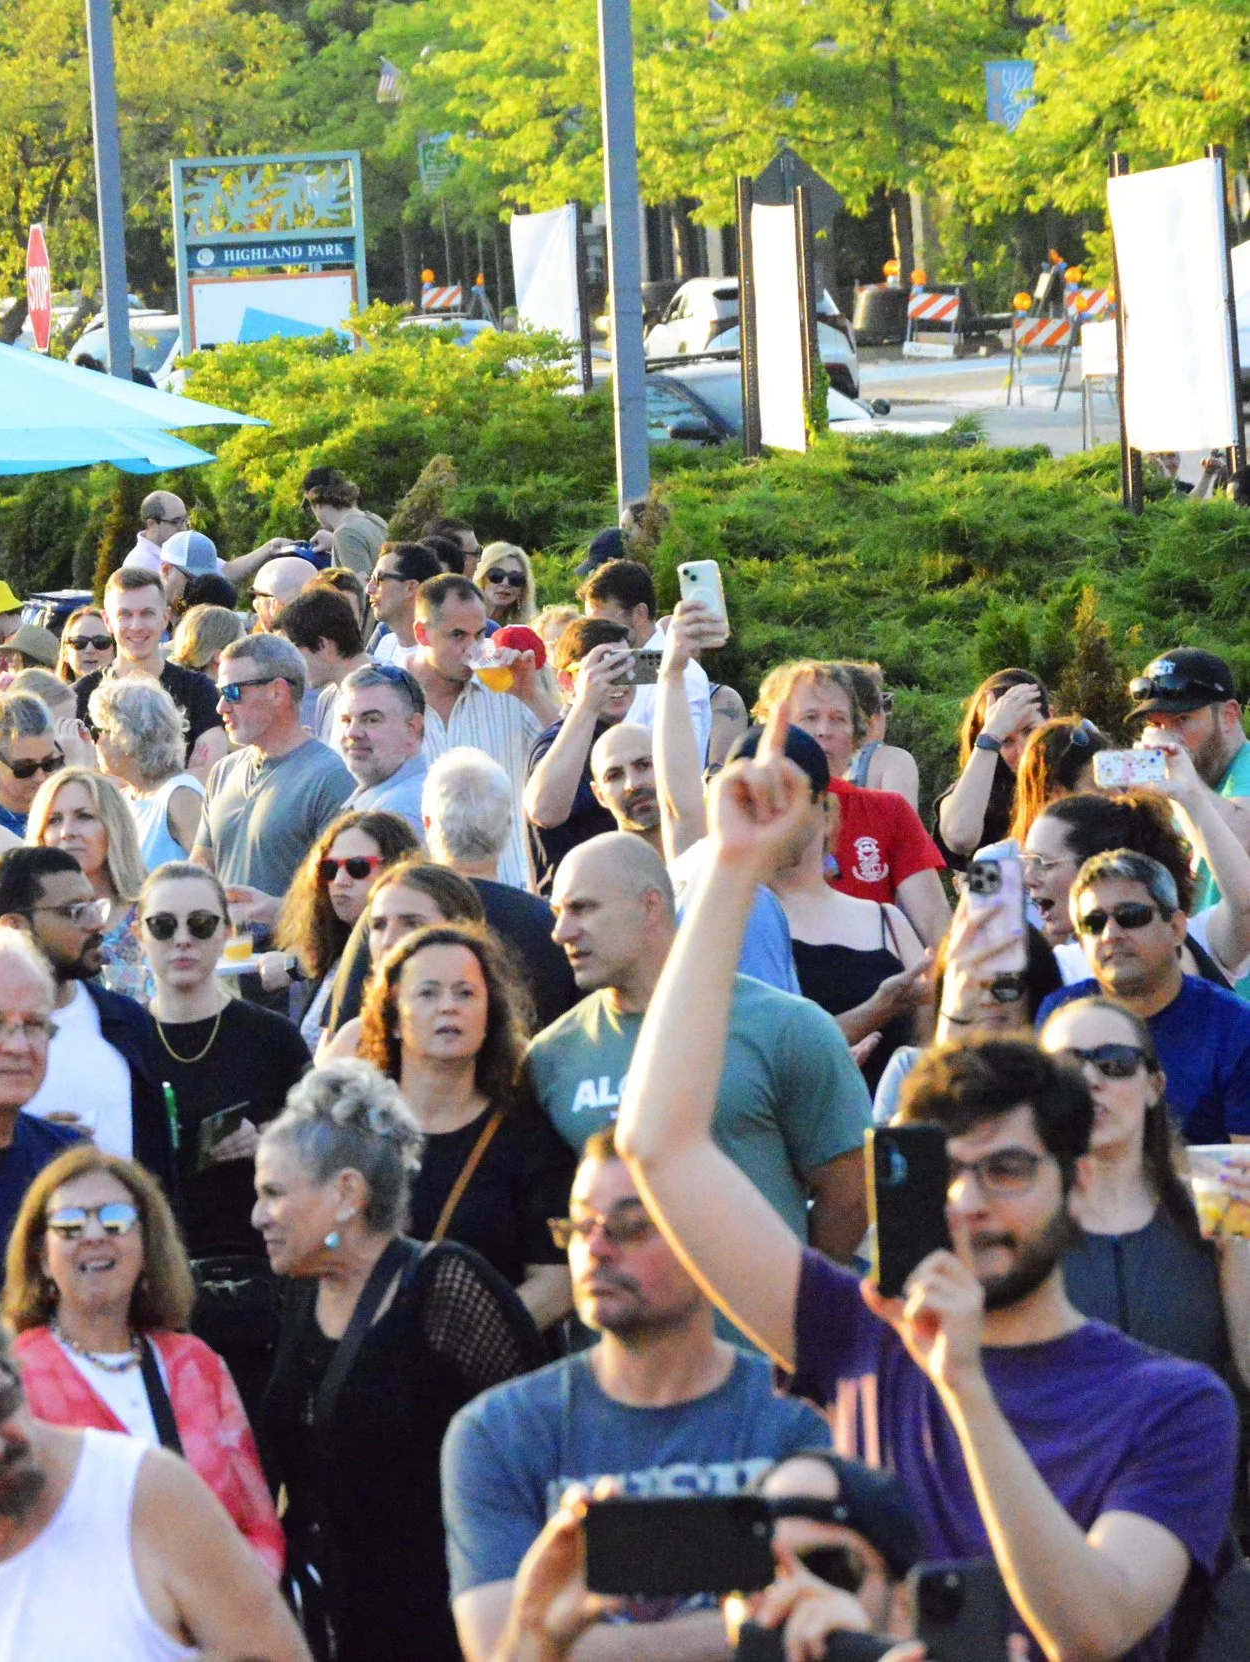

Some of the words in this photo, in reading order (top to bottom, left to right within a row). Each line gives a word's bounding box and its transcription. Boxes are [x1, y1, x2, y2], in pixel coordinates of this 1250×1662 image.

[223, 245, 303, 262] HIGHLAND
[307, 243, 345, 258] PARK
[28, 265, 49, 311] STOP
